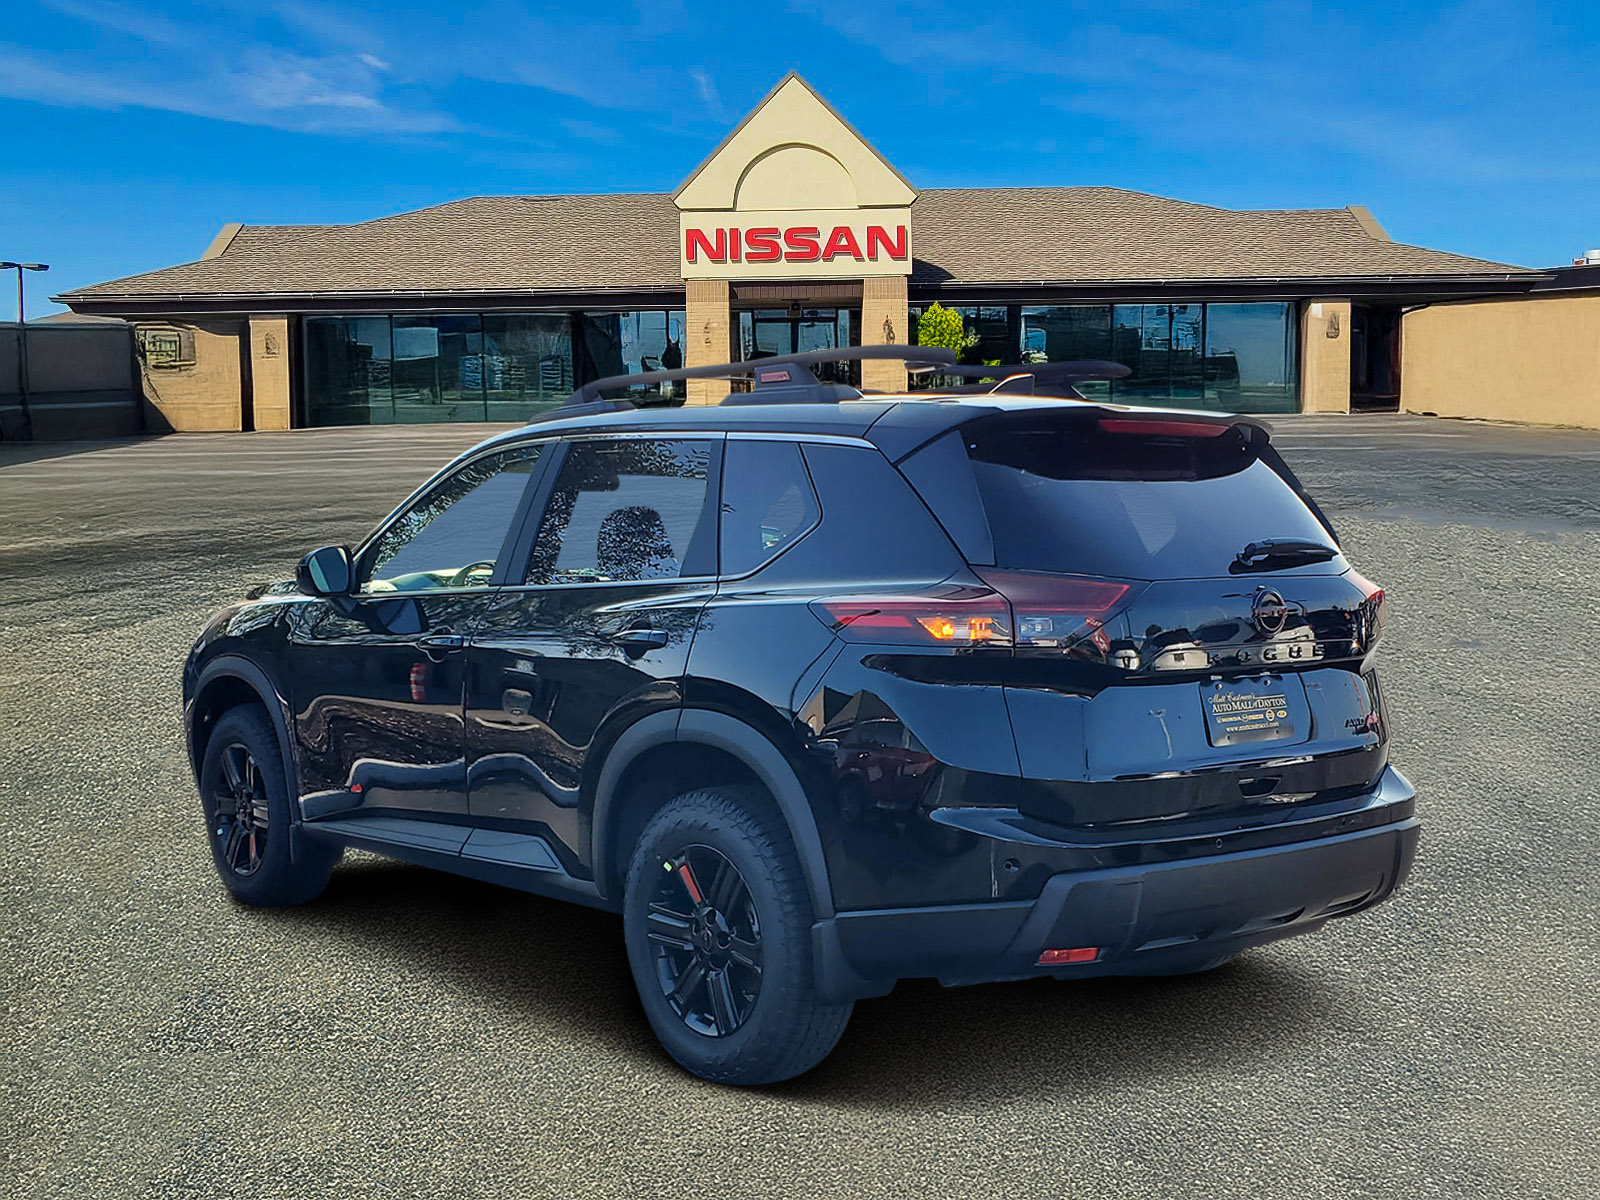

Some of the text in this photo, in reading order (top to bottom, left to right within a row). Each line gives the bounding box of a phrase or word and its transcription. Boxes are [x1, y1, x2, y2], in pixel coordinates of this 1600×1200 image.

[685, 225, 908, 264] NISSAN
[1207, 643, 1325, 665] ROGUE
[1212, 703, 1232, 713] AUTO
[1232, 701, 1253, 711] MALL
[1257, 698, 1286, 708] DAYTON
